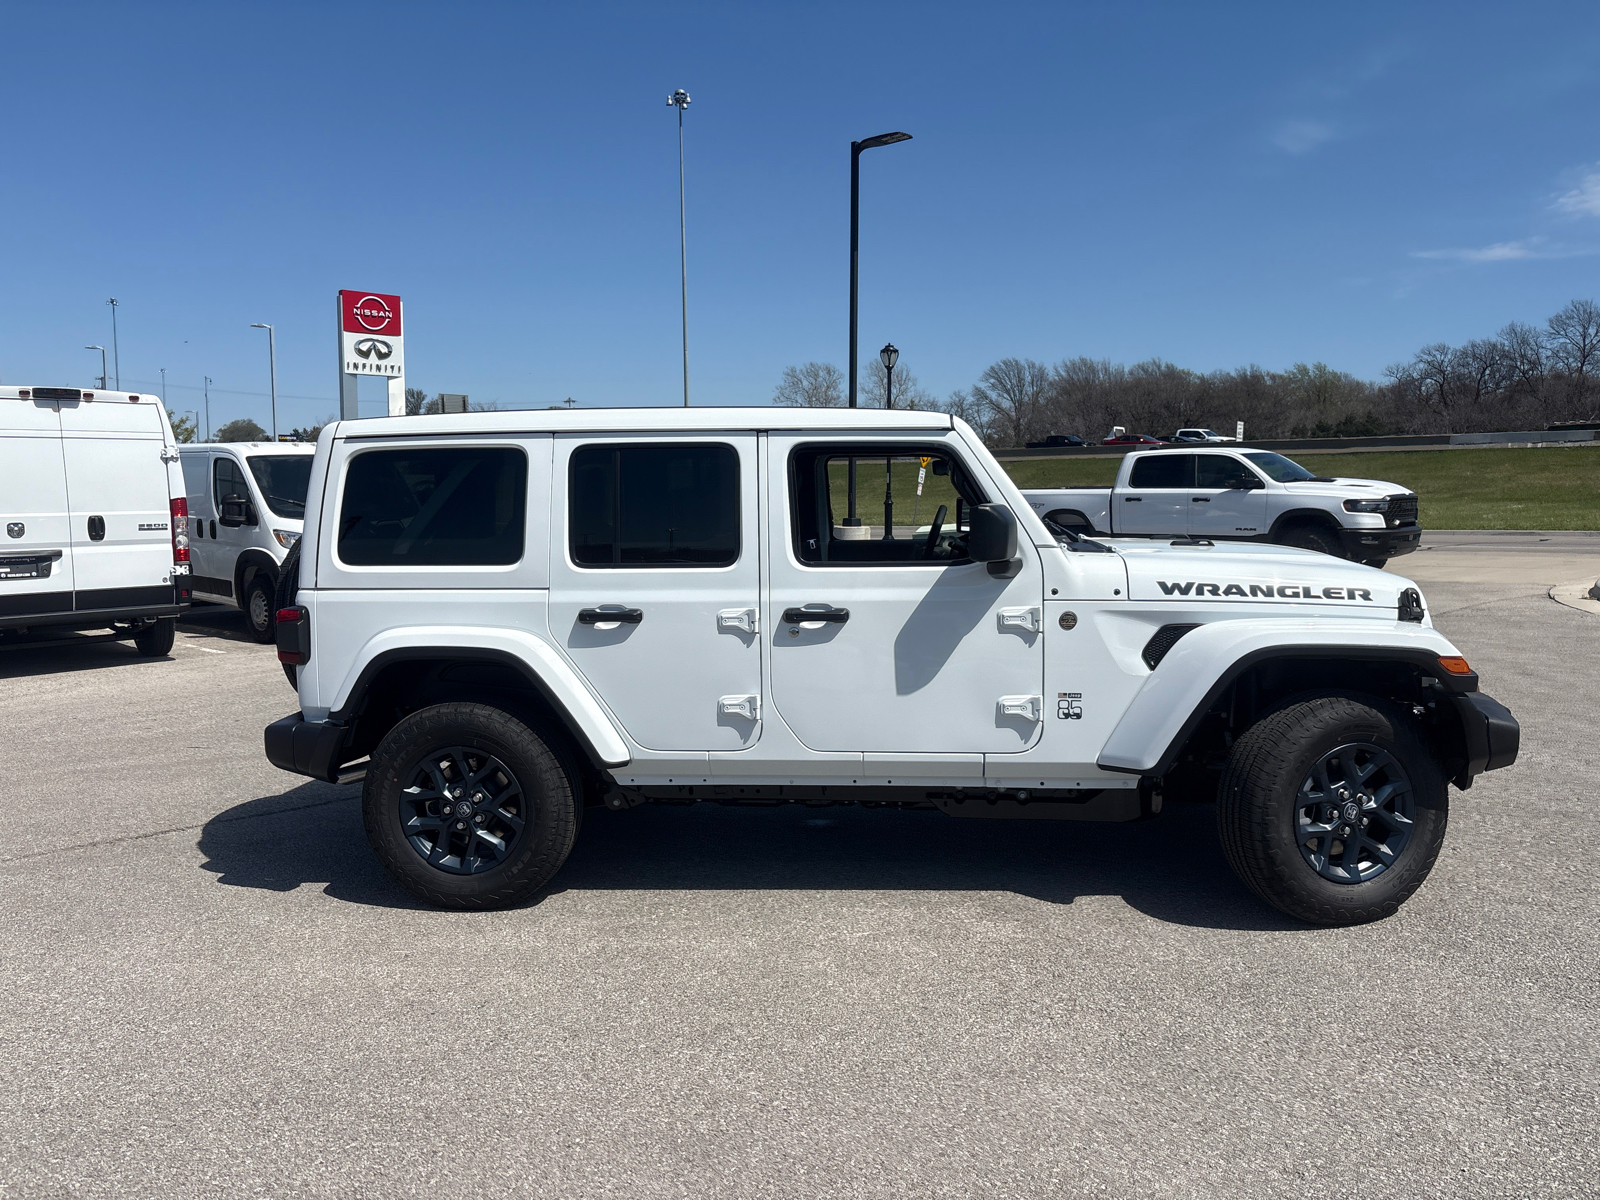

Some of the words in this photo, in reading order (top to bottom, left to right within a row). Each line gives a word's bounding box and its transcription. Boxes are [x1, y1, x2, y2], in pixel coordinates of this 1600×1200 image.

[353, 308, 392, 318] NISSAN
[346, 361, 401, 374] INFINITI
[1156, 580, 1373, 601] WRANGLER
[1057, 699, 1082, 719] 85
